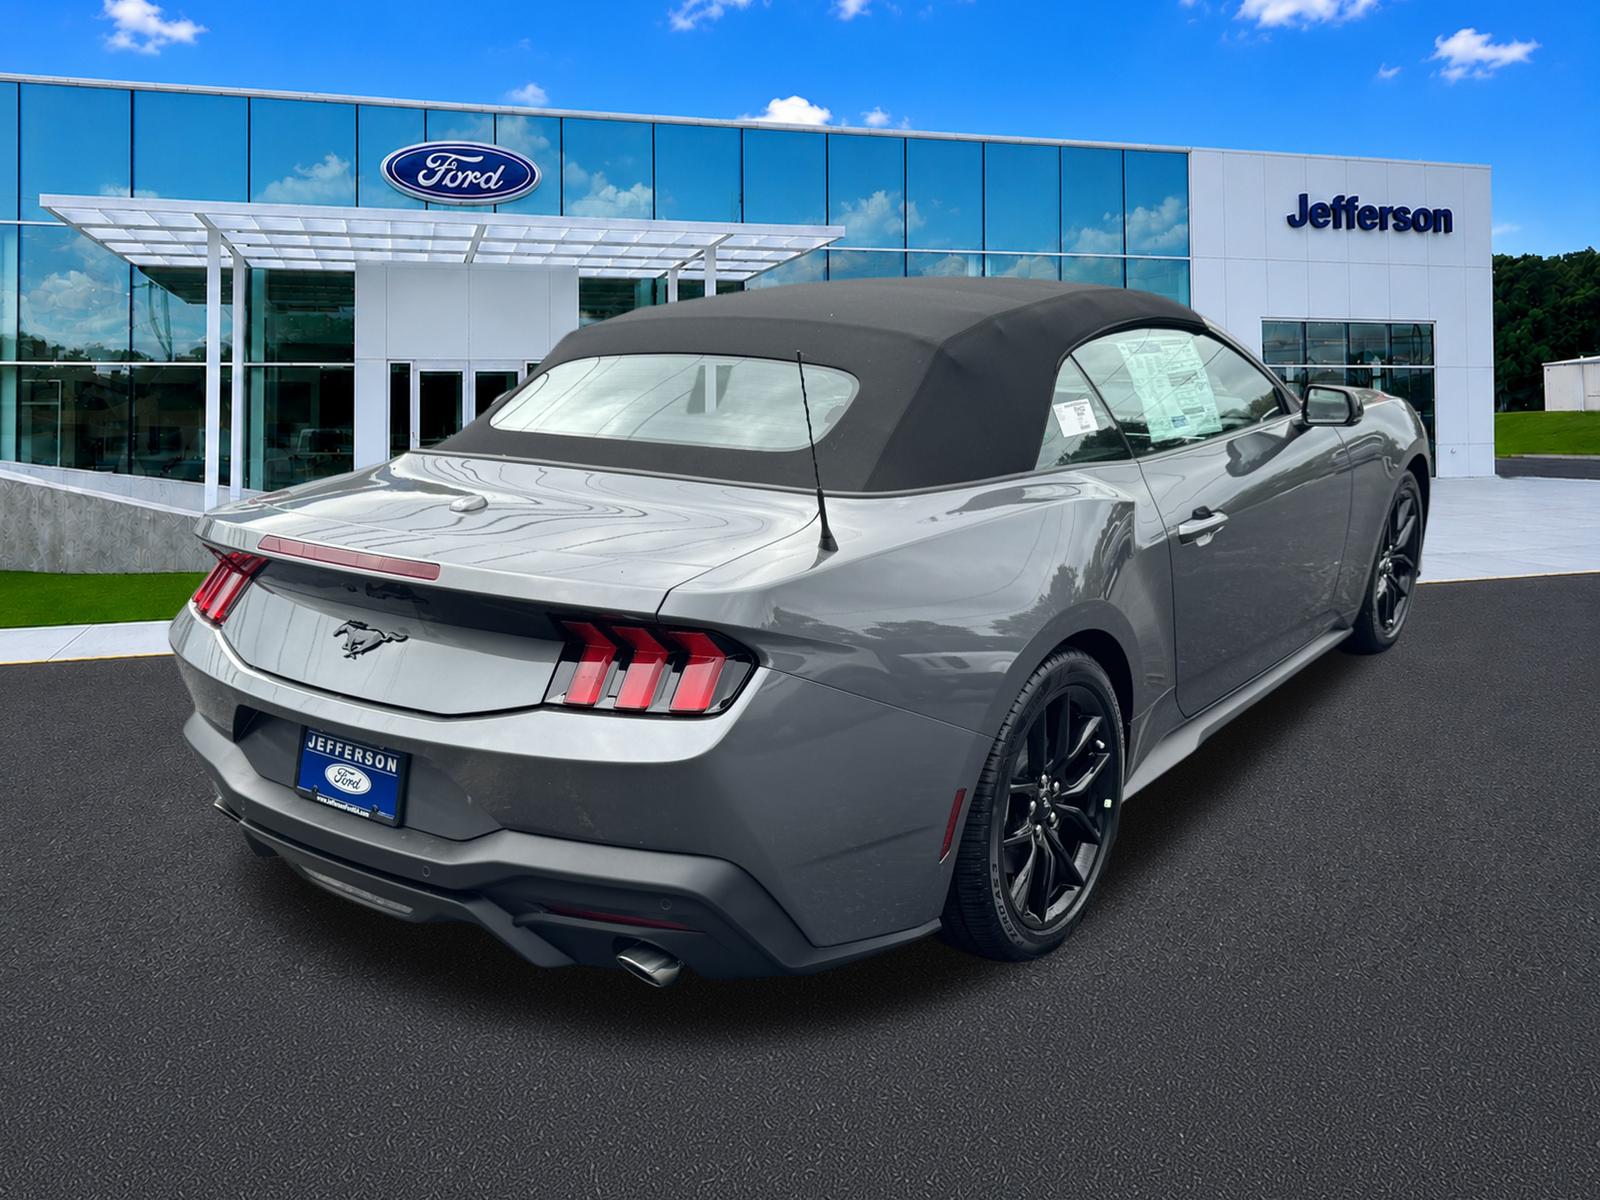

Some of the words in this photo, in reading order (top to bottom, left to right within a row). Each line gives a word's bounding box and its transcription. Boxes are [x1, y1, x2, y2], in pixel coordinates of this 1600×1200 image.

[417, 152, 506, 190] Ford
[1286, 192, 1453, 234] Jefferson
[308, 735, 398, 773] JEFFERSON
[333, 767, 362, 790] Ford
